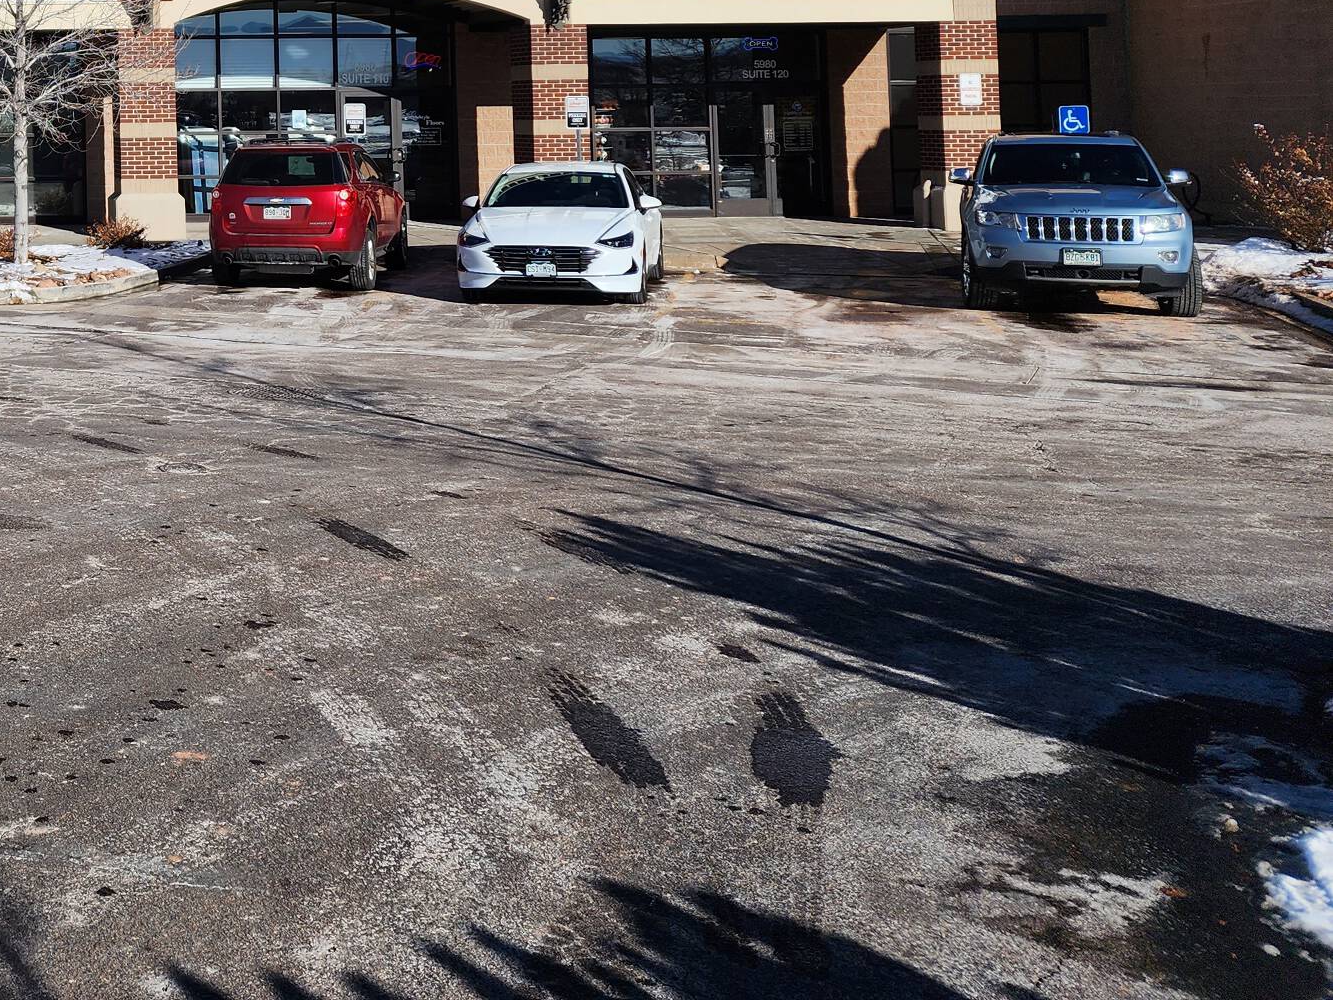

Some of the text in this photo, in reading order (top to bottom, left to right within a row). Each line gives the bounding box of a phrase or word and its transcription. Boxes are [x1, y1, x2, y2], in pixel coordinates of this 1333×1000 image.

[754, 60, 776, 68] 5980
[342, 73, 369, 83] SUITE
[742, 70, 789, 78] SUITE 120
